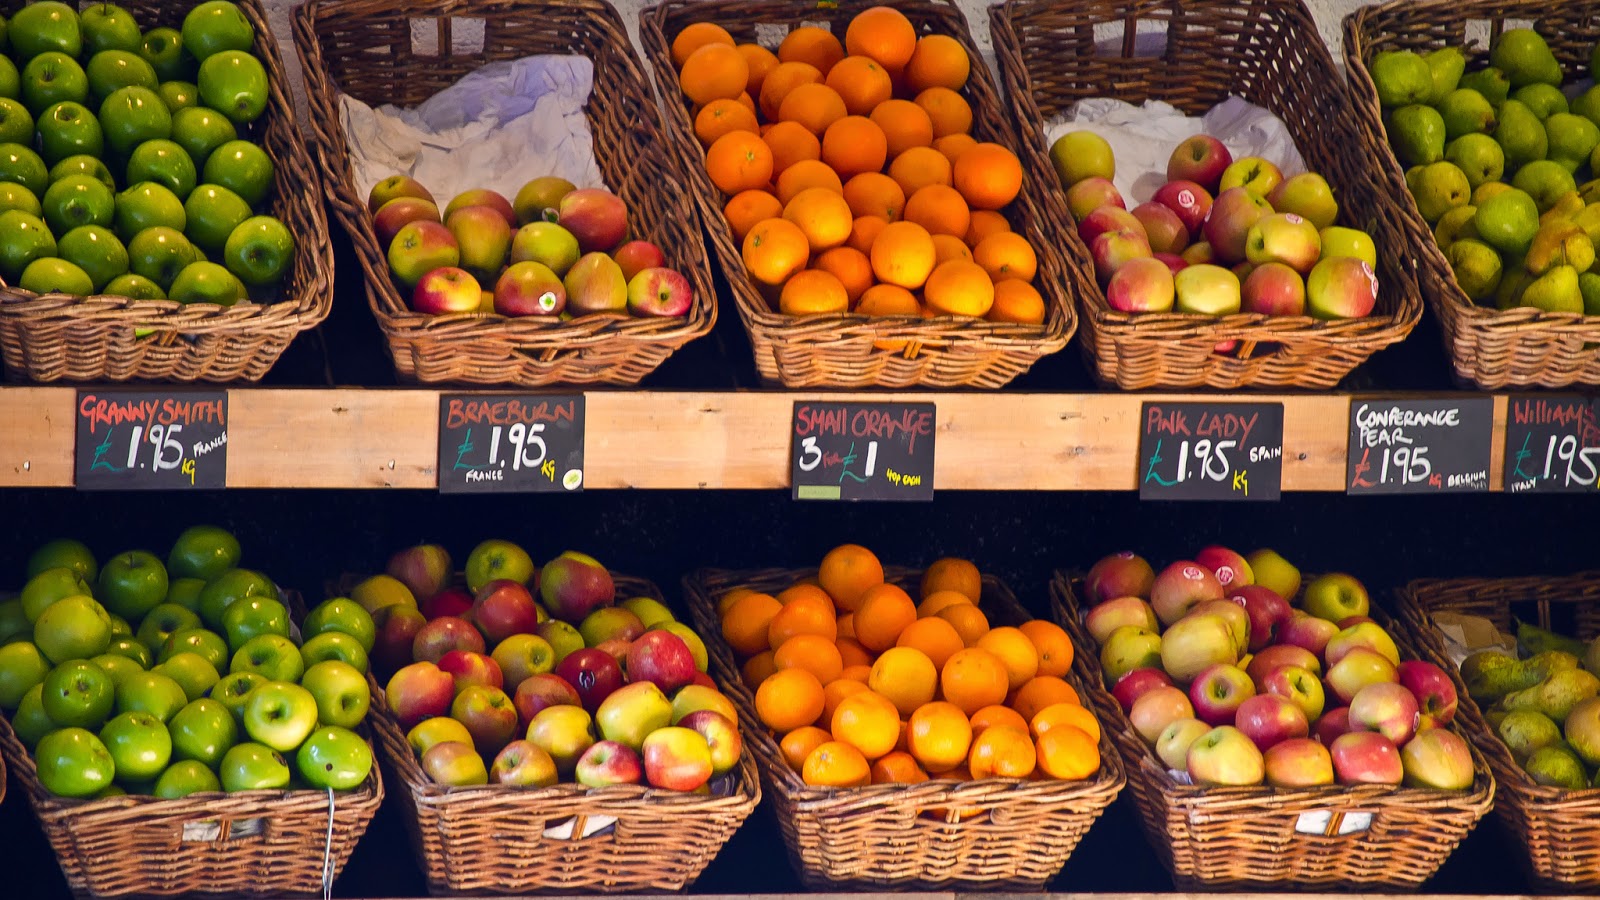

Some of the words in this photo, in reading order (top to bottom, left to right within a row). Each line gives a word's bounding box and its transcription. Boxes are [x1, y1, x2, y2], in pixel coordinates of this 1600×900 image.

[80, 395, 159, 442] GRANNY
[158, 398, 225, 425] SMITH
[447, 399, 575, 429] BRAEBURN
[1356, 403, 1460, 428] CONFERANCE
[193, 430, 228, 458] FRANCE
[851, 409, 933, 455] ORANGE
[1196, 411, 1259, 451] LADY
[1360, 427, 1413, 449] PEAR
[799, 436, 822, 471] 3
[1249, 445, 1282, 463] SPAIN
[465, 469, 504, 483] FRANCE
[1233, 469, 1248, 496] KG
[1447, 470, 1487, 488] BELGIUM
[1511, 476, 1537, 493] ITALY
